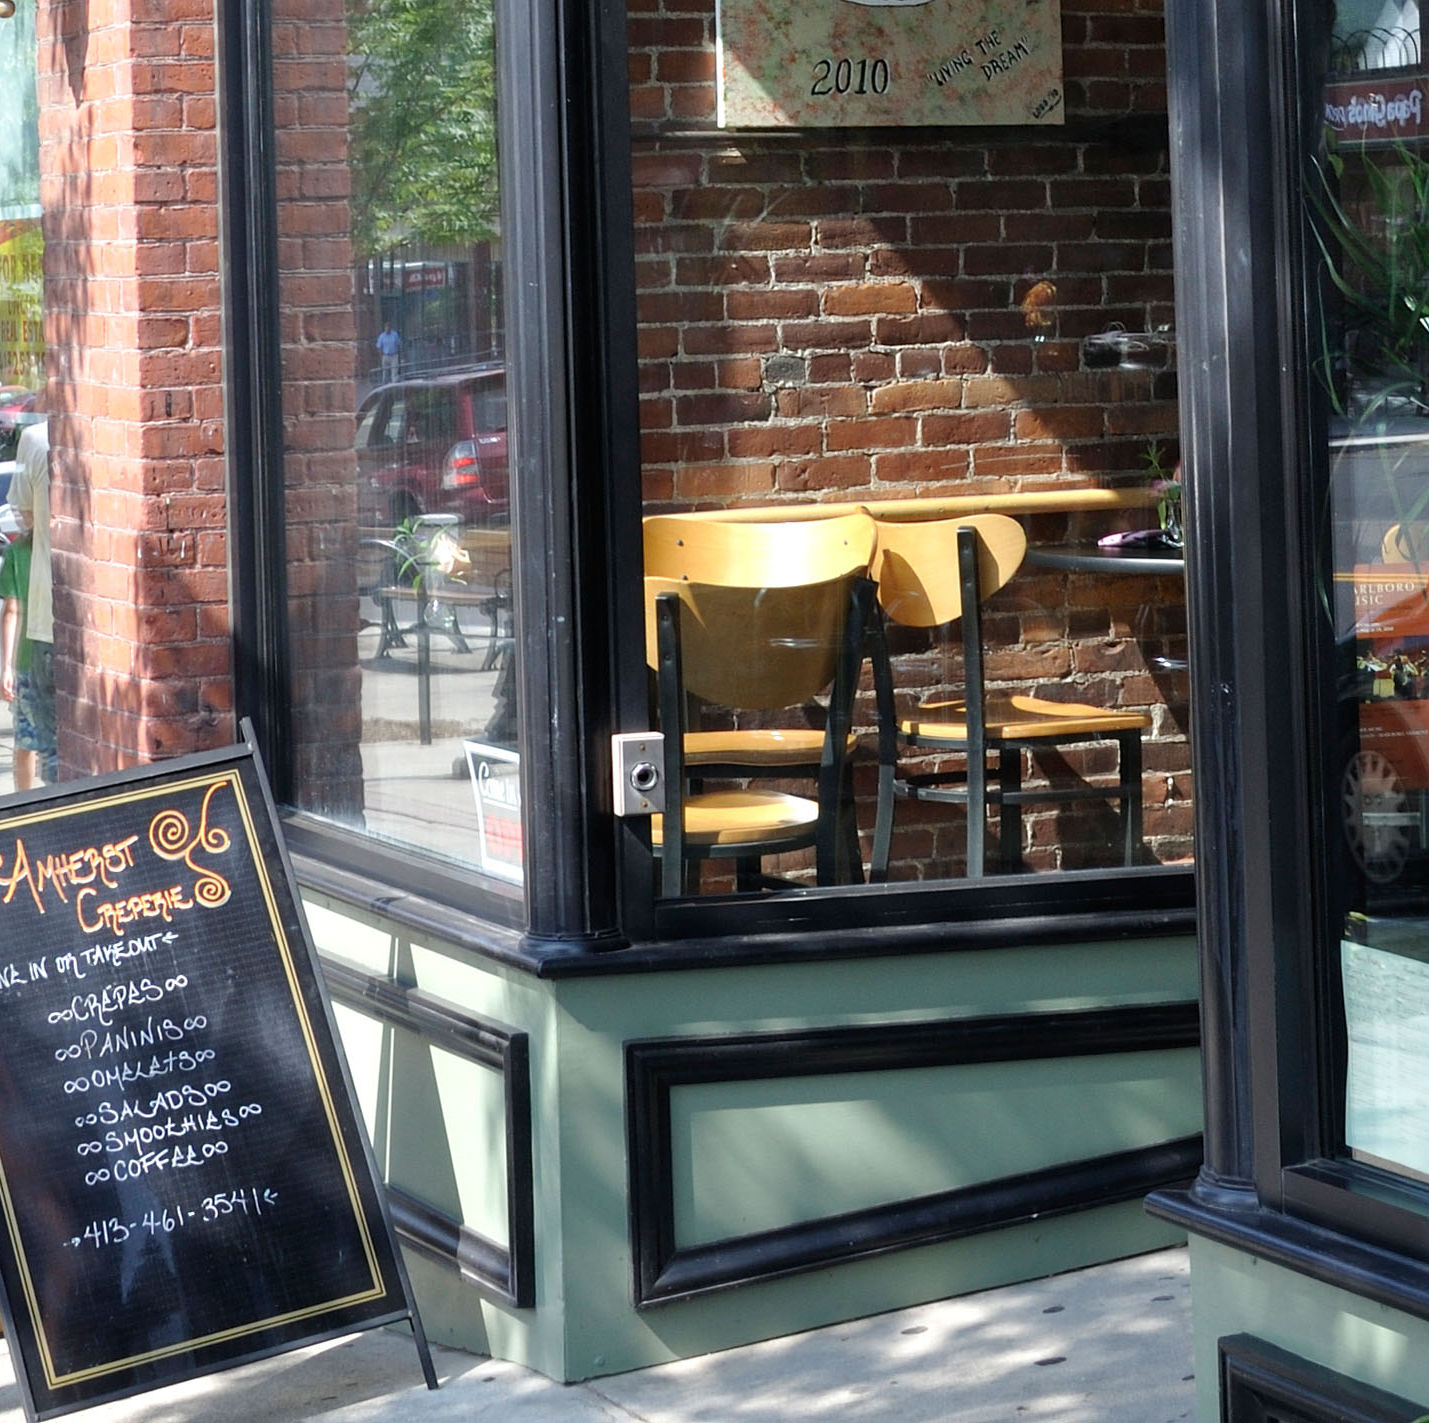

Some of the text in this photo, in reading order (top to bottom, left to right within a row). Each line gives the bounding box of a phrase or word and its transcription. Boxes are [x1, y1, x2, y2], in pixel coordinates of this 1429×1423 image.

[975, 30, 1002, 56] THE
[810, 58, 891, 96] 2010
[29, 957, 48, 982] IN
[80, 933, 163, 967] TAKEOUT
[80, 1016, 184, 1059] PANINIS
[99, 1085, 207, 1124] SALADS
[114, 1145, 205, 1181] COFFEE
